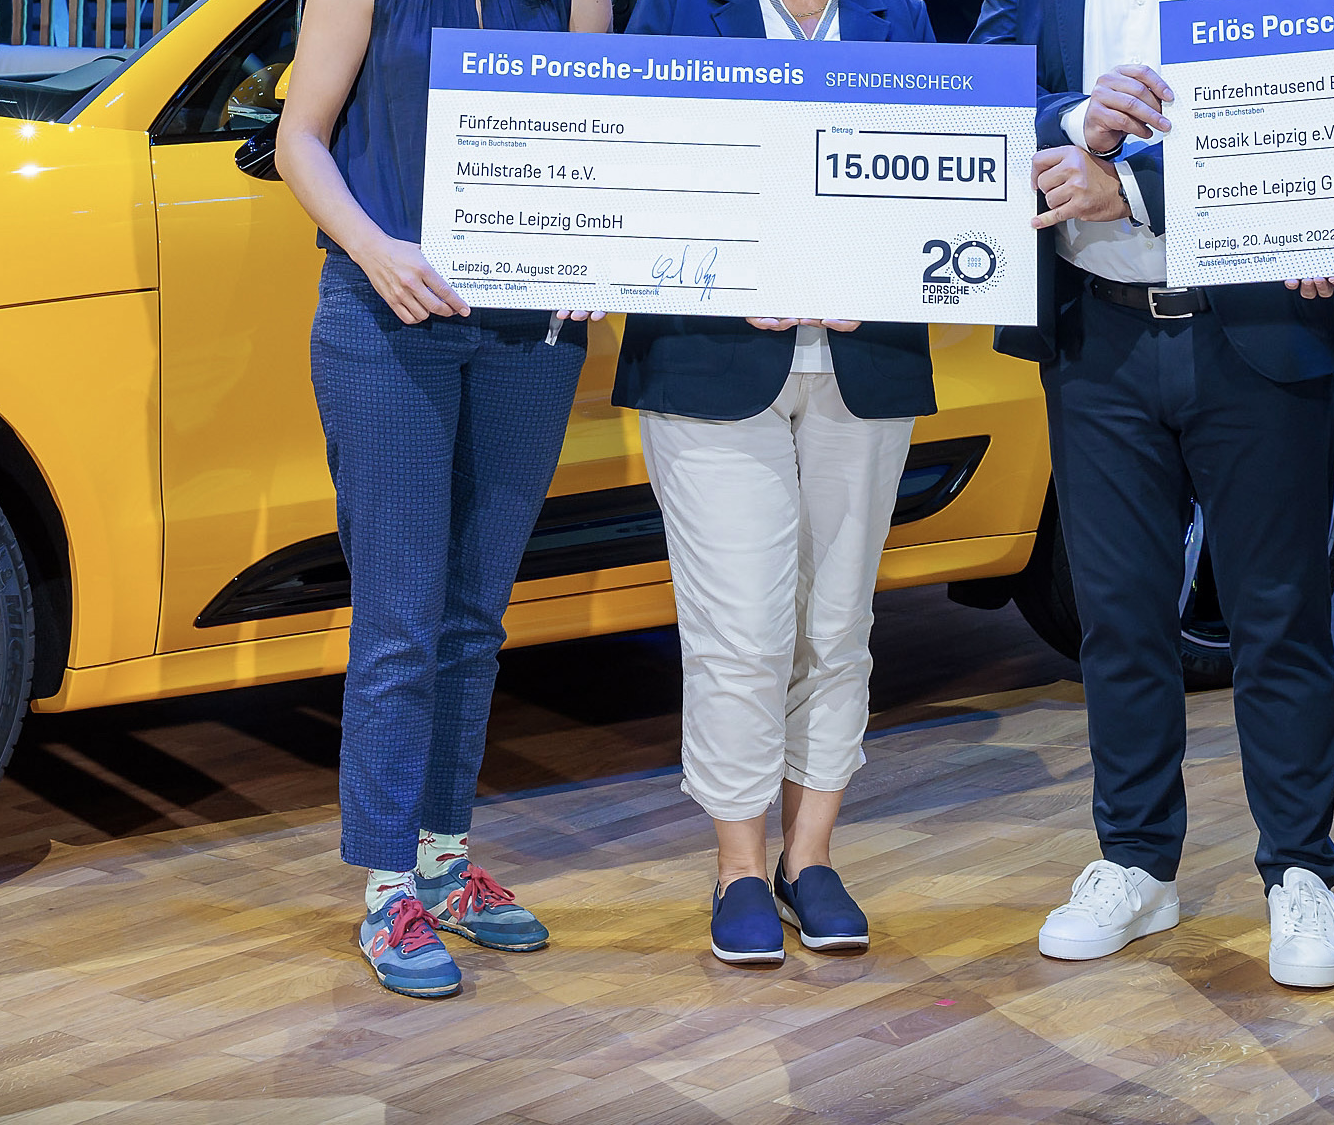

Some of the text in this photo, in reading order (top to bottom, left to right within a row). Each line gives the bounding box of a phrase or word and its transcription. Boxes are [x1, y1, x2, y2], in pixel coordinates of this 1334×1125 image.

[1191, 18, 1255, 44] Erlös
[462, 52, 804, 85] Erlös Porsche-Jubiläumseis
[825, 72, 974, 90] SPENDENSCHECK
[1193, 76, 1325, 101] Fünfzehntausend
[1193, 107, 1265, 119] Betrag in Buchstaben
[459, 114, 625, 134] Fünfzehntausend Euro
[831, 126, 853, 135] Betrag
[457, 138, 480, 148] Betrag
[488, 139, 527, 148] Buchstaben
[1196, 132, 1250, 150] Mosaik
[1254, 128, 1307, 147] Leipzig
[456, 161, 596, 181] Mühlstraße 14 e.V.
[826, 153, 997, 183] 15.000 EUR
[1197, 182, 1258, 199] Porsche
[1262, 177, 1316, 196] Leipzig
[454, 209, 623, 230] Porsche Leipzig GmbH
[1198, 235, 1240, 250] Leipzig,
[1242, 234, 1260, 246] 20.
[1263, 231, 1304, 247] August
[452, 260, 588, 277] Leipzig, 20. August 2022
[922, 239, 996, 284] 20
[922, 284, 969, 295] PORSCHE
[922, 295, 960, 304] LEIPZIG
